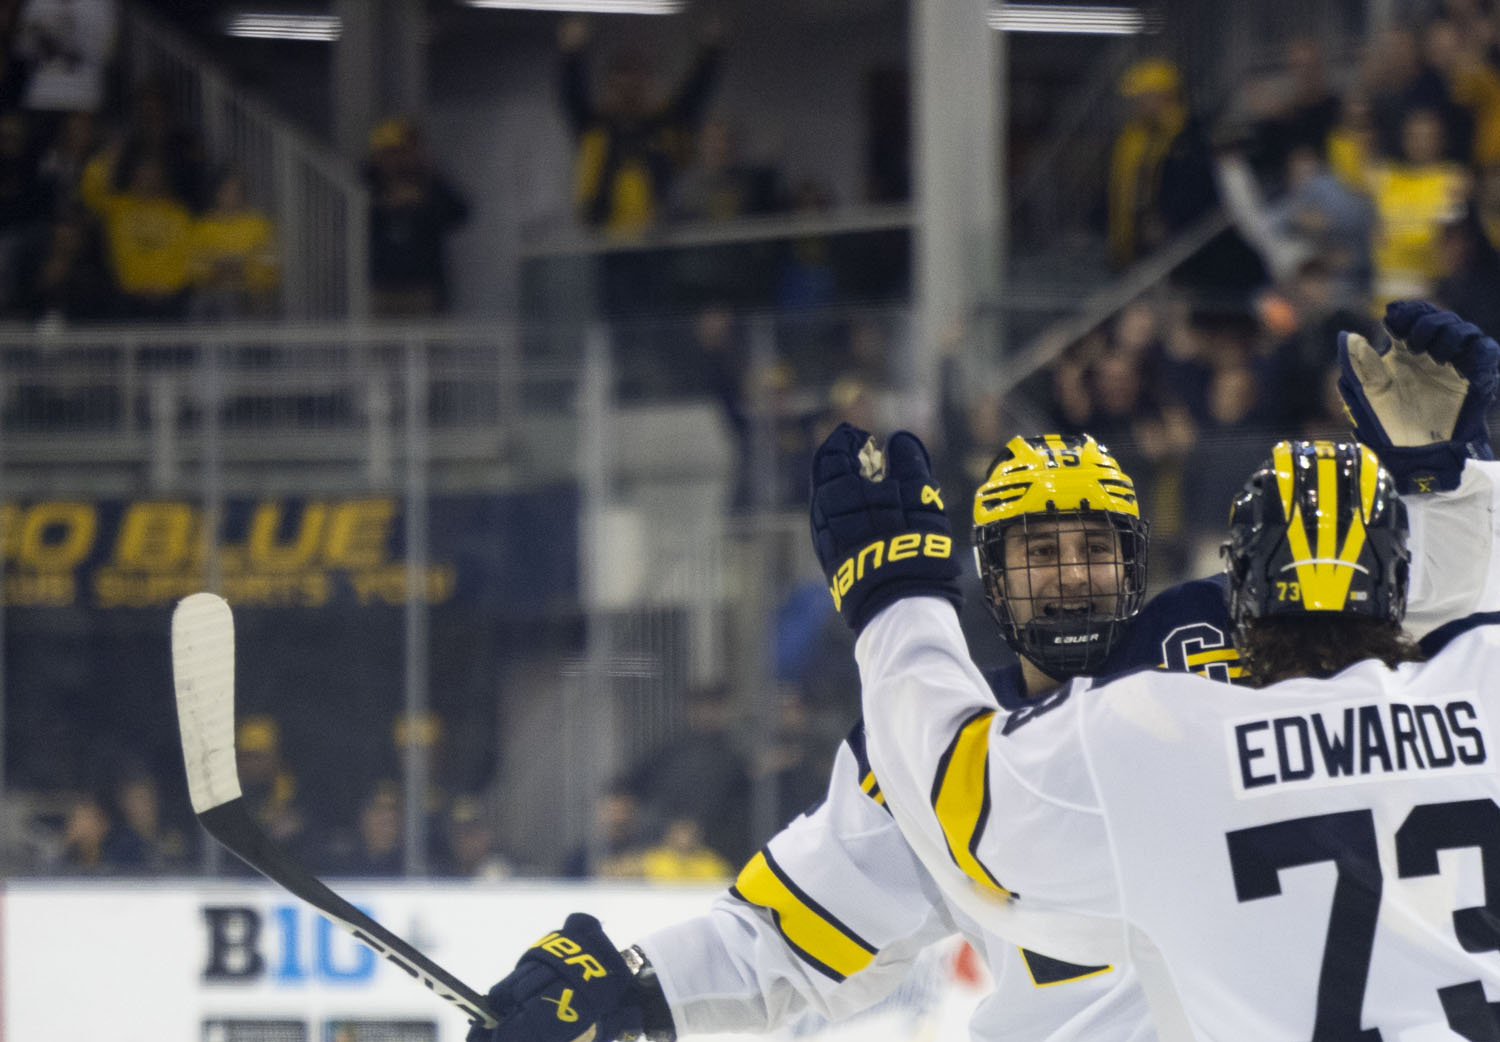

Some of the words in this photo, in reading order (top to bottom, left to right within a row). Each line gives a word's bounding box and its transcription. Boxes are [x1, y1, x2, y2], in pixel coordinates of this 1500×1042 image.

[1046, 448, 1081, 467] 15
[115, 499, 395, 570] BLUE
[1275, 581, 1300, 602] 73
[1235, 700, 1487, 790] EDWARDS
